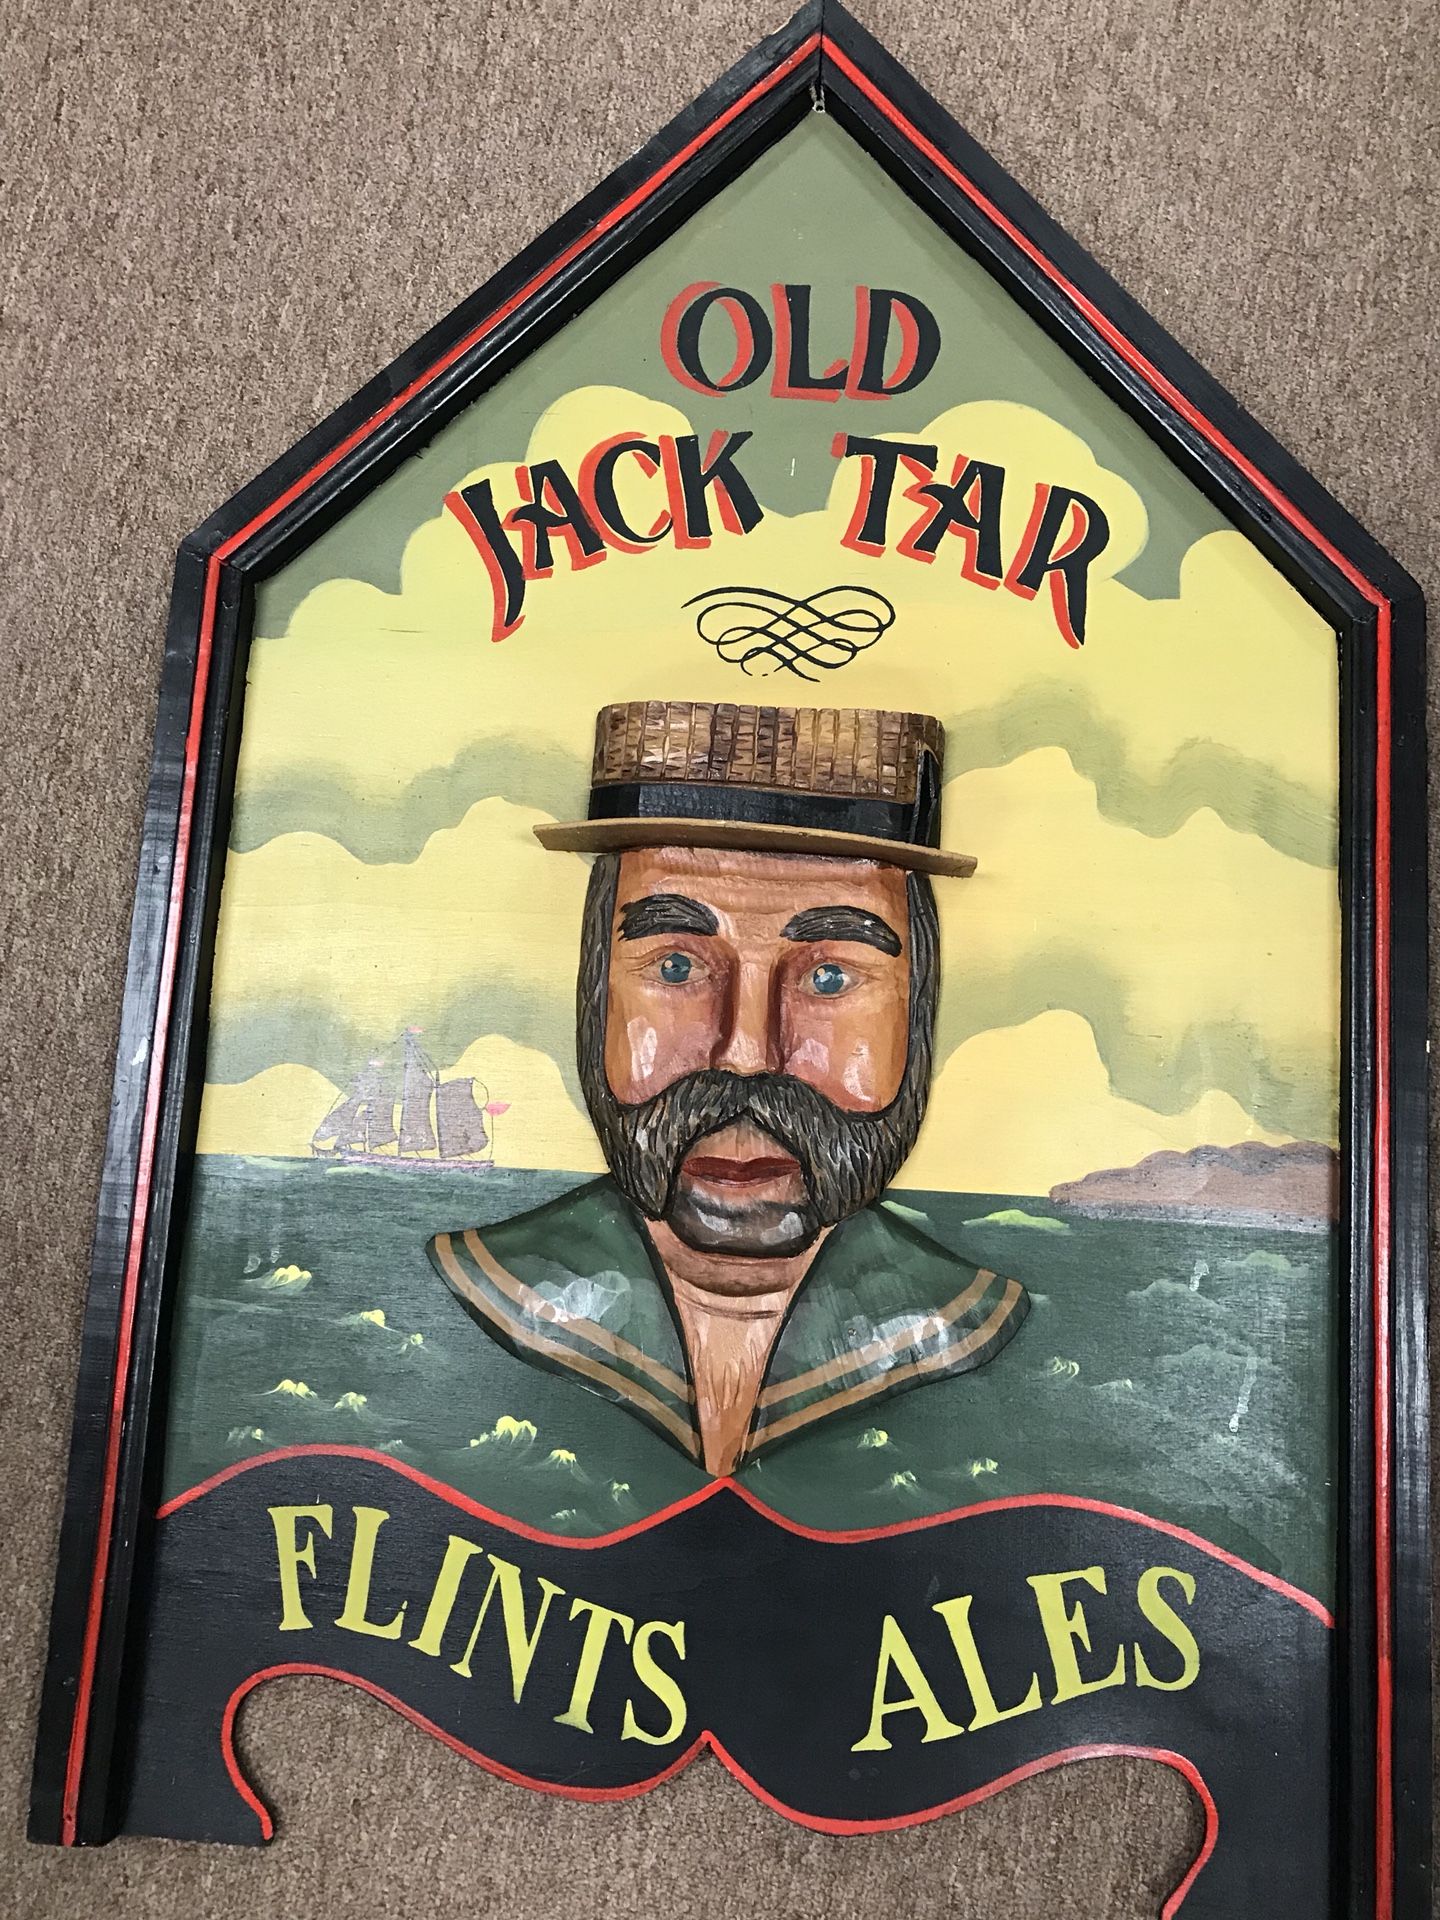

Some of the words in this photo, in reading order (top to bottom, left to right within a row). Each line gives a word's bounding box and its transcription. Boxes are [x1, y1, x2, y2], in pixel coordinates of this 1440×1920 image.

[660, 281, 941, 403] OLD
[444, 429, 764, 643] JACK
[830, 431, 1110, 650] TAR
[267, 1503, 687, 1746] FLINTS
[850, 1565, 1200, 1752] ALES
